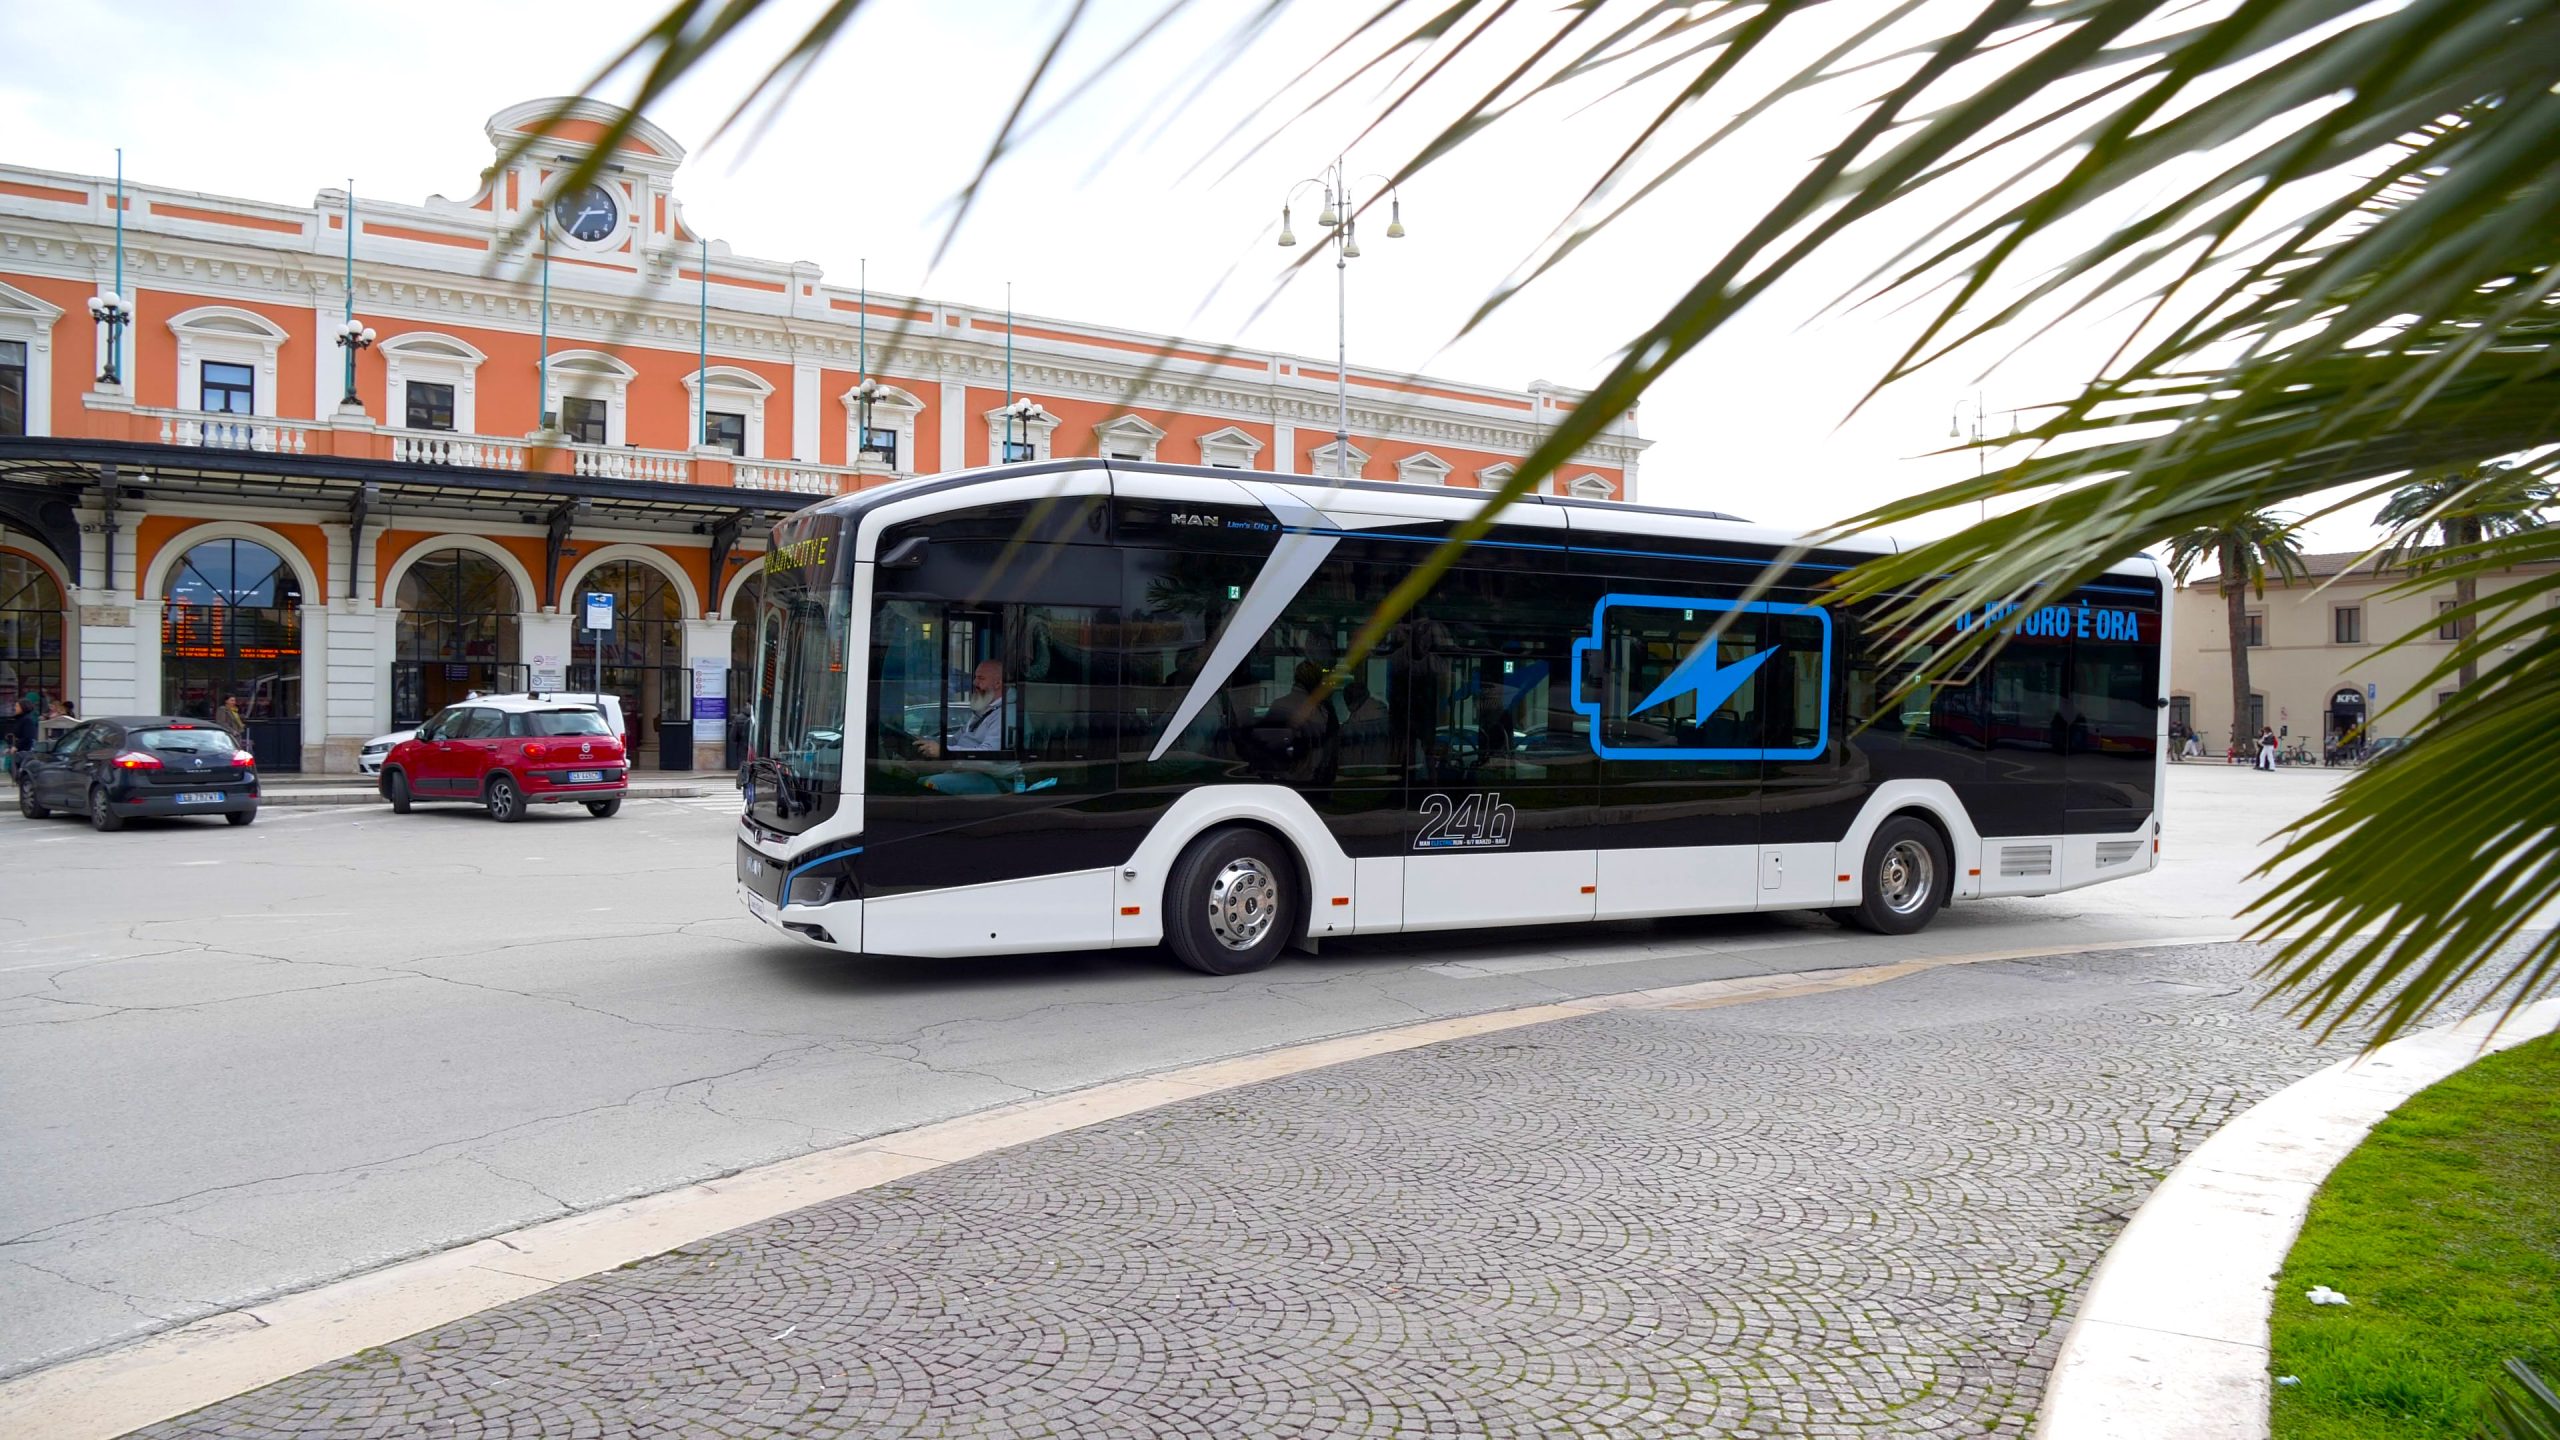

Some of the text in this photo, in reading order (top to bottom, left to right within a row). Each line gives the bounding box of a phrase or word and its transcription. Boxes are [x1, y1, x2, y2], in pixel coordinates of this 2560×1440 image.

[1171, 513, 1219, 527] MAN
[1227, 520, 1279, 531] Lion's City E
[818, 537, 829, 565] E
[2077, 599, 2090, 639] È
[2096, 609, 2139, 641] ORA
[2336, 694, 2360, 703] KFC
[1414, 792, 1516, 840] 24h
